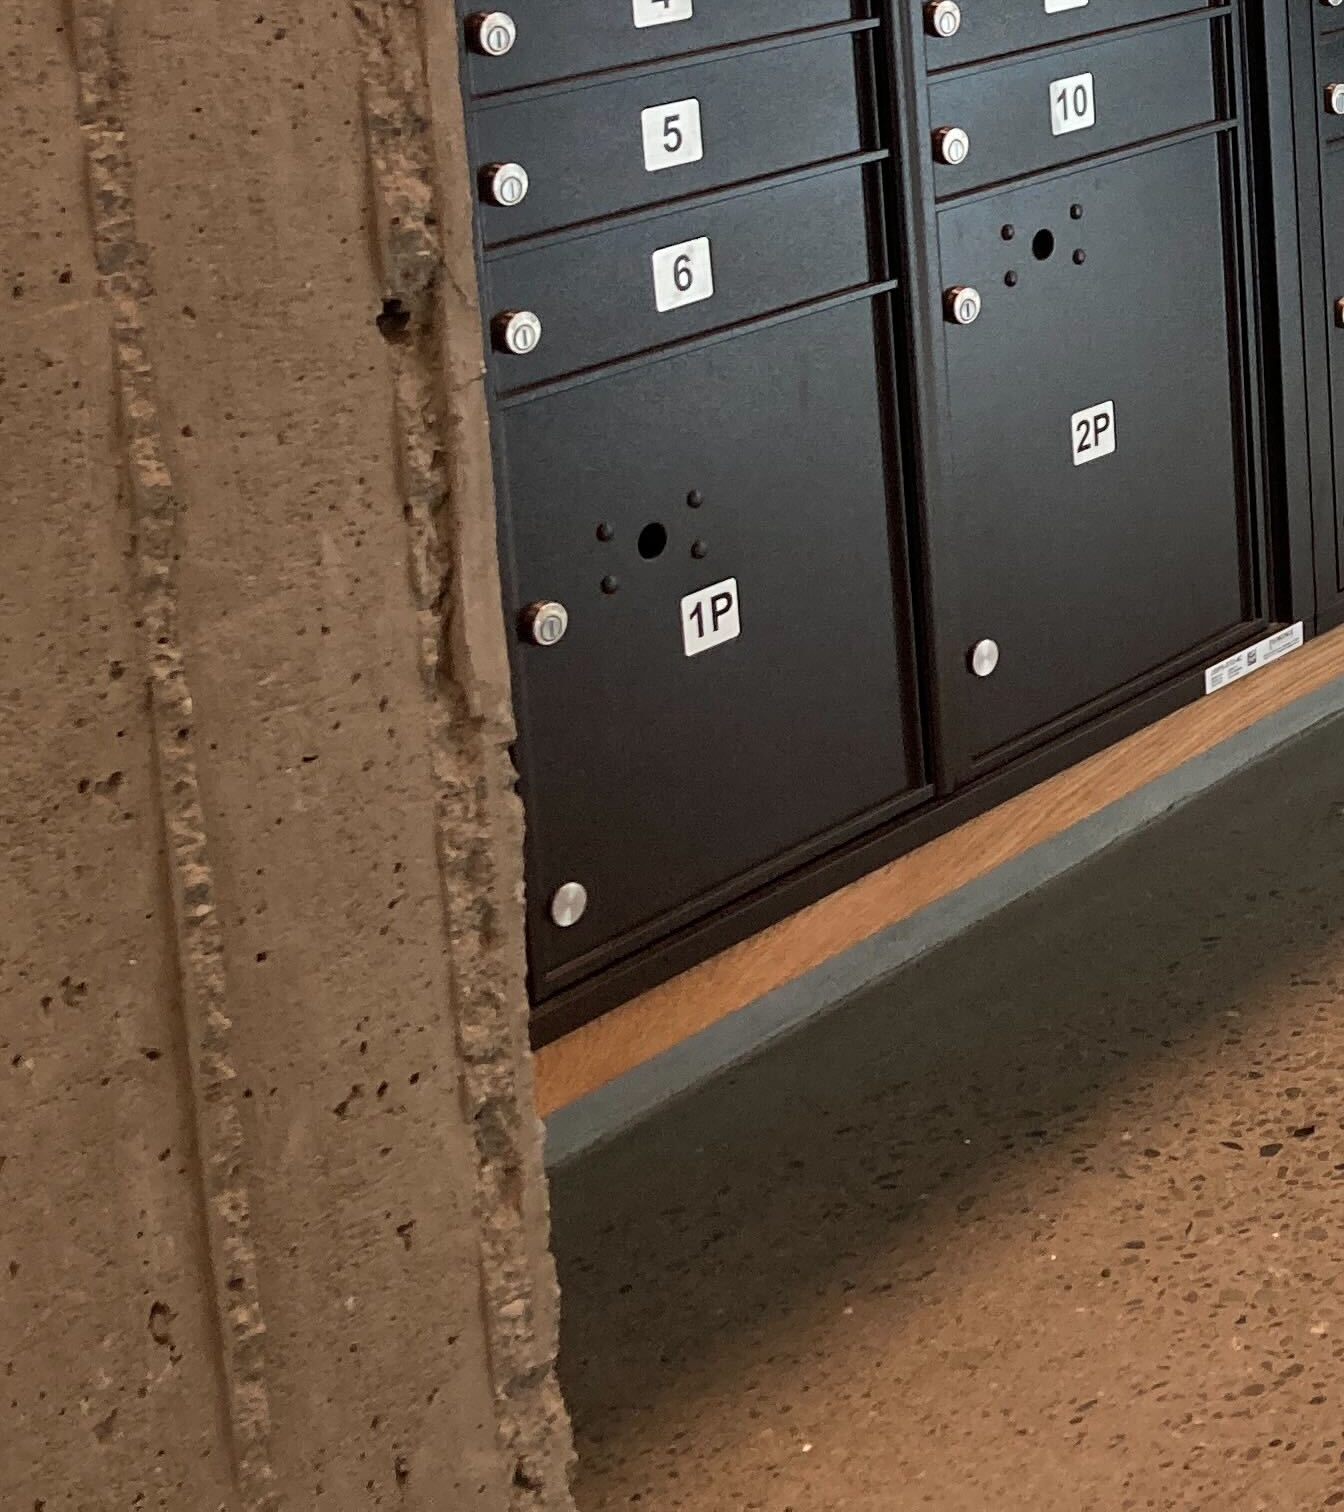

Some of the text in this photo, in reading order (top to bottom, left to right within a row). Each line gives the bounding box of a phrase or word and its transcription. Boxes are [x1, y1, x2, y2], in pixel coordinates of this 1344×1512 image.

[1056, 84, 1087, 121] 10
[663, 114, 683, 153] 5
[673, 254, 693, 292] 6
[1076, 412, 1110, 454] 2P
[689, 591, 733, 638] 1P
